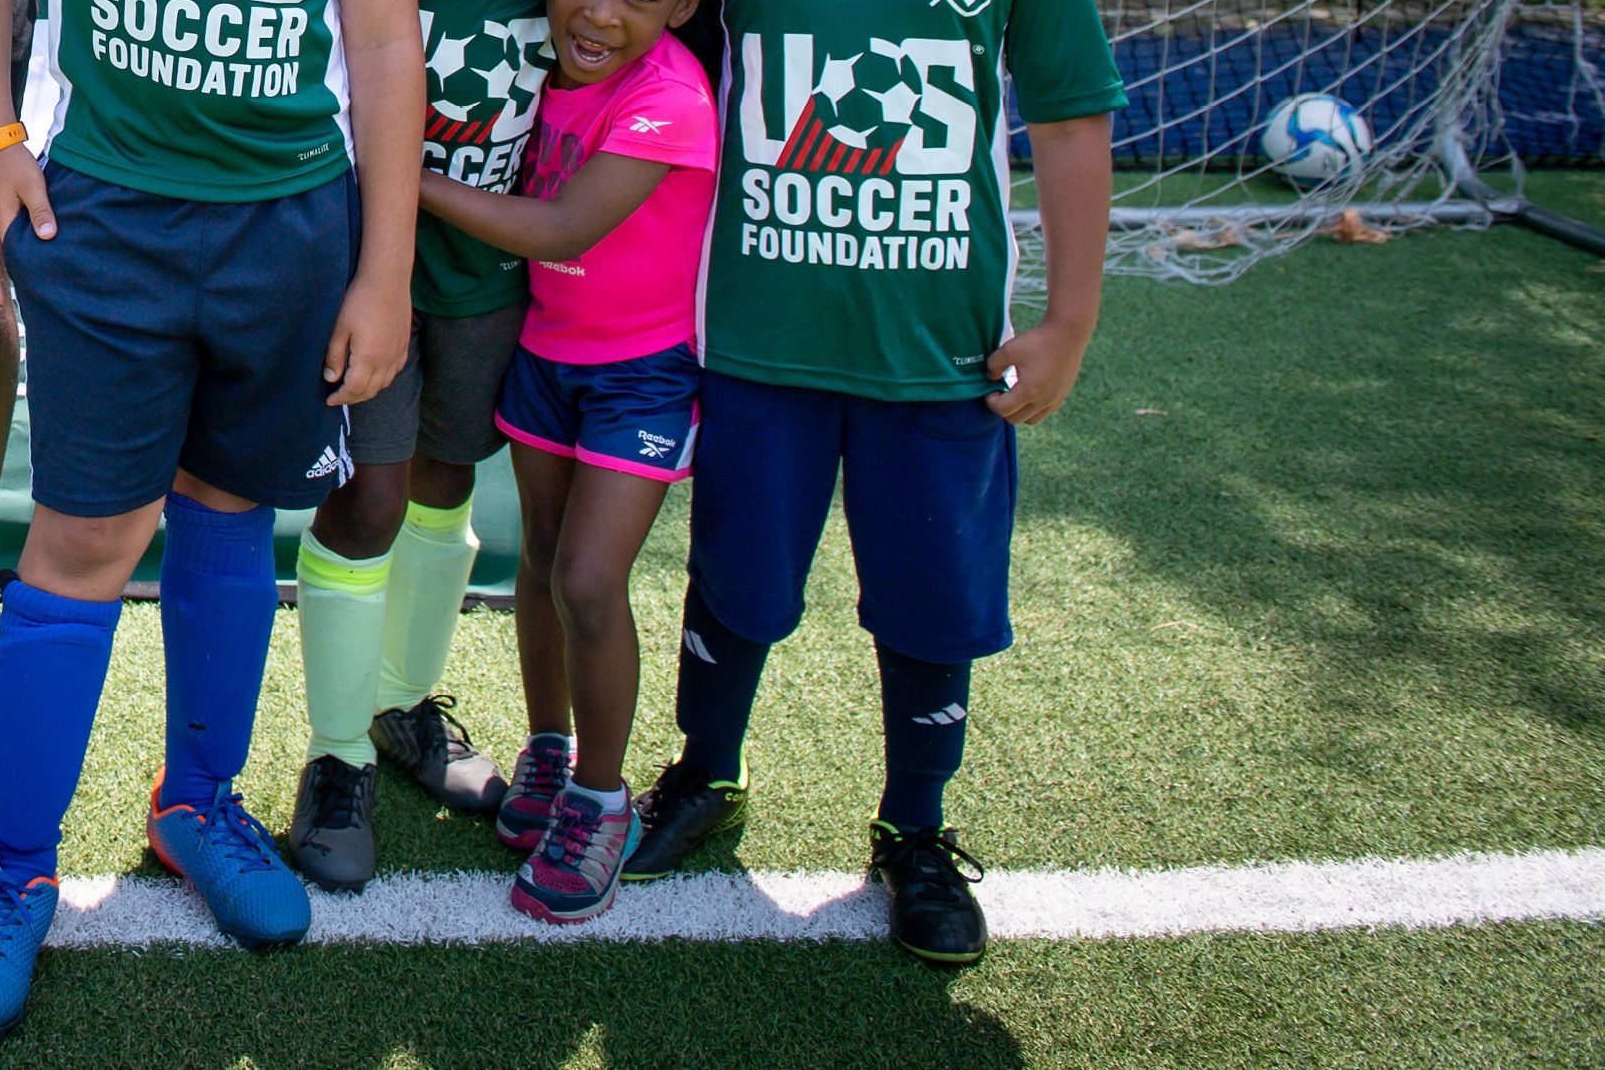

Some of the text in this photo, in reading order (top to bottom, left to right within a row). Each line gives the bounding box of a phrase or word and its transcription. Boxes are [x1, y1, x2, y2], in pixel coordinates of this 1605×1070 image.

[93, 29, 299, 98] FOUNDATION
[423, 133, 531, 188] CCER
[741, 168, 971, 232] SOCCER
[741, 223, 970, 270] FOUNDATION
[637, 430, 677, 448] Reebok
